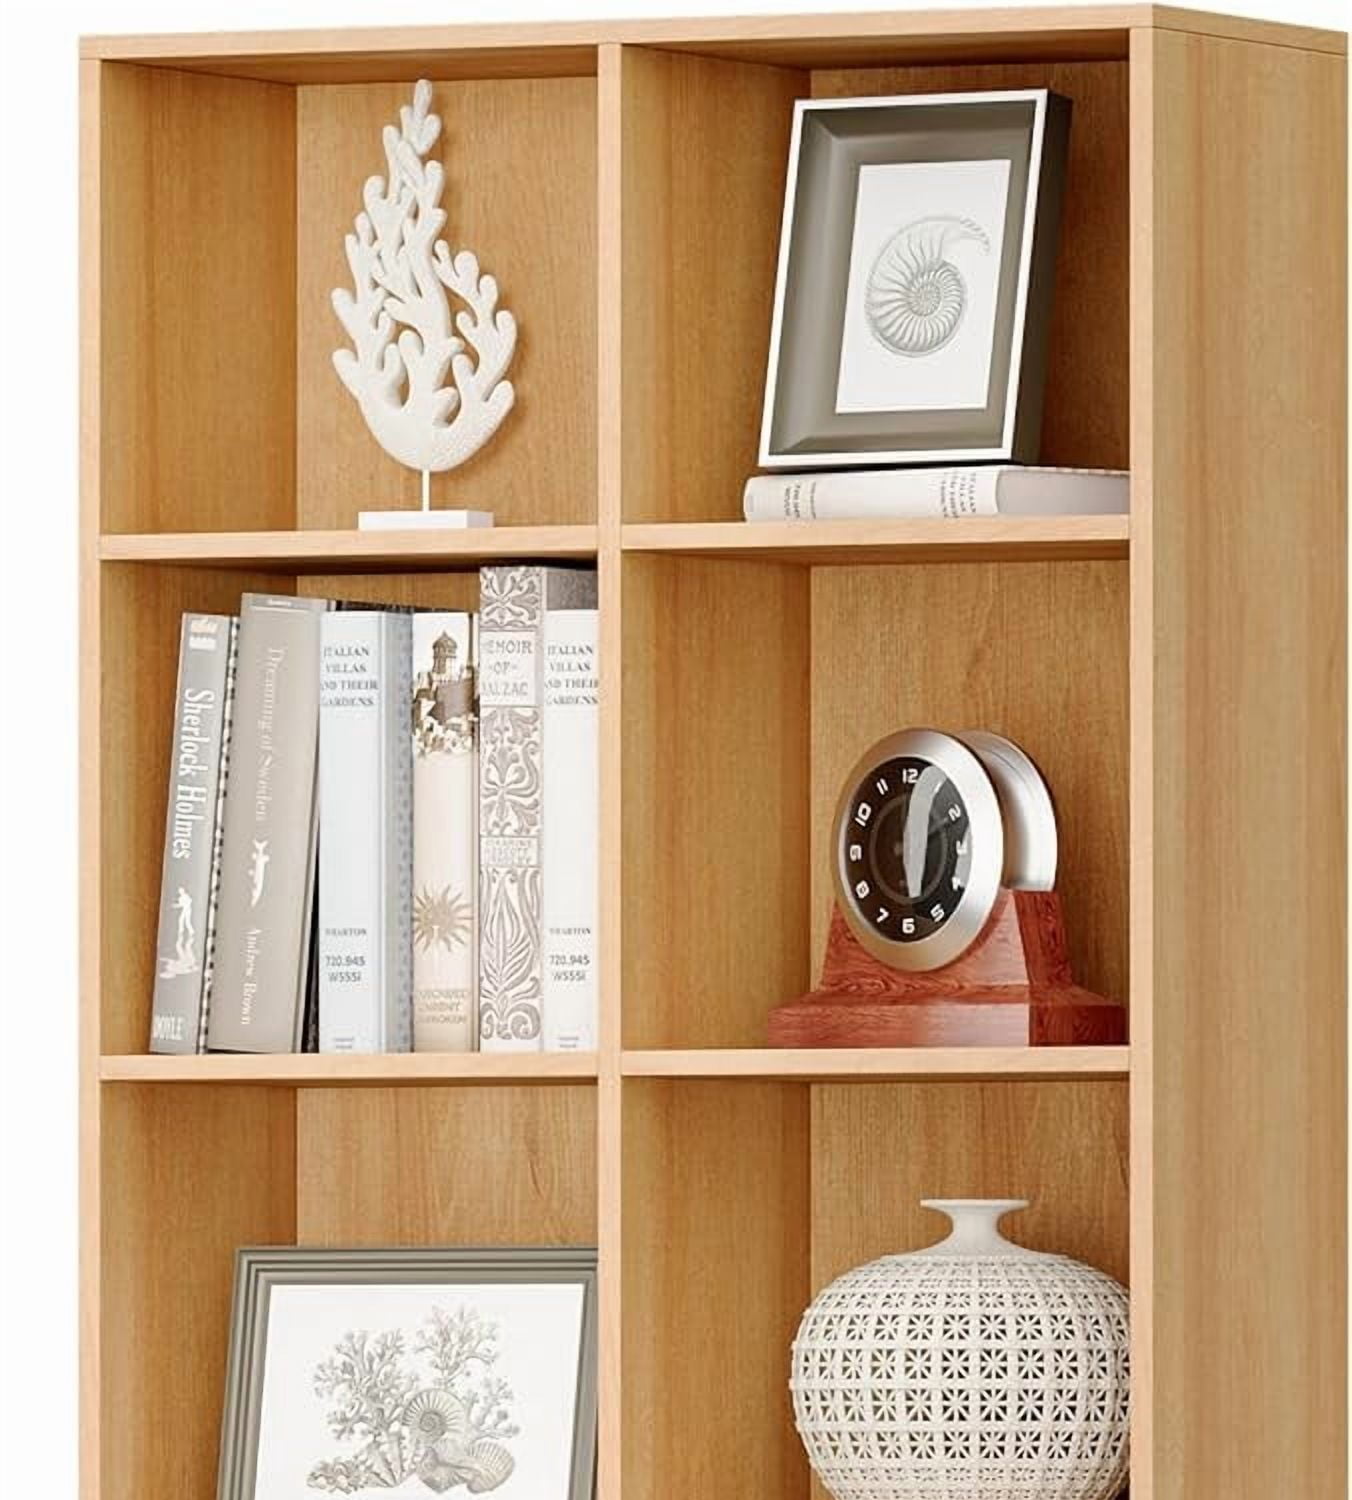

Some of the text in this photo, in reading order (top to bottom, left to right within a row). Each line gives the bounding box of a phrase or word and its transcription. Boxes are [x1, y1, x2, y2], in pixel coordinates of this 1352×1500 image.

[178, 688, 215, 776] Sherlock
[902, 768, 918, 784] 12
[876, 779, 888, 795] 11
[855, 803, 872, 827] 10
[948, 803, 961, 821] 2
[172, 784, 207, 859] Holmes
[850, 845, 861, 862] 9
[855, 882, 870, 899] 8
[876, 908, 889, 923] 7
[930, 904, 945, 922] 5
[902, 918, 915, 934] 6
